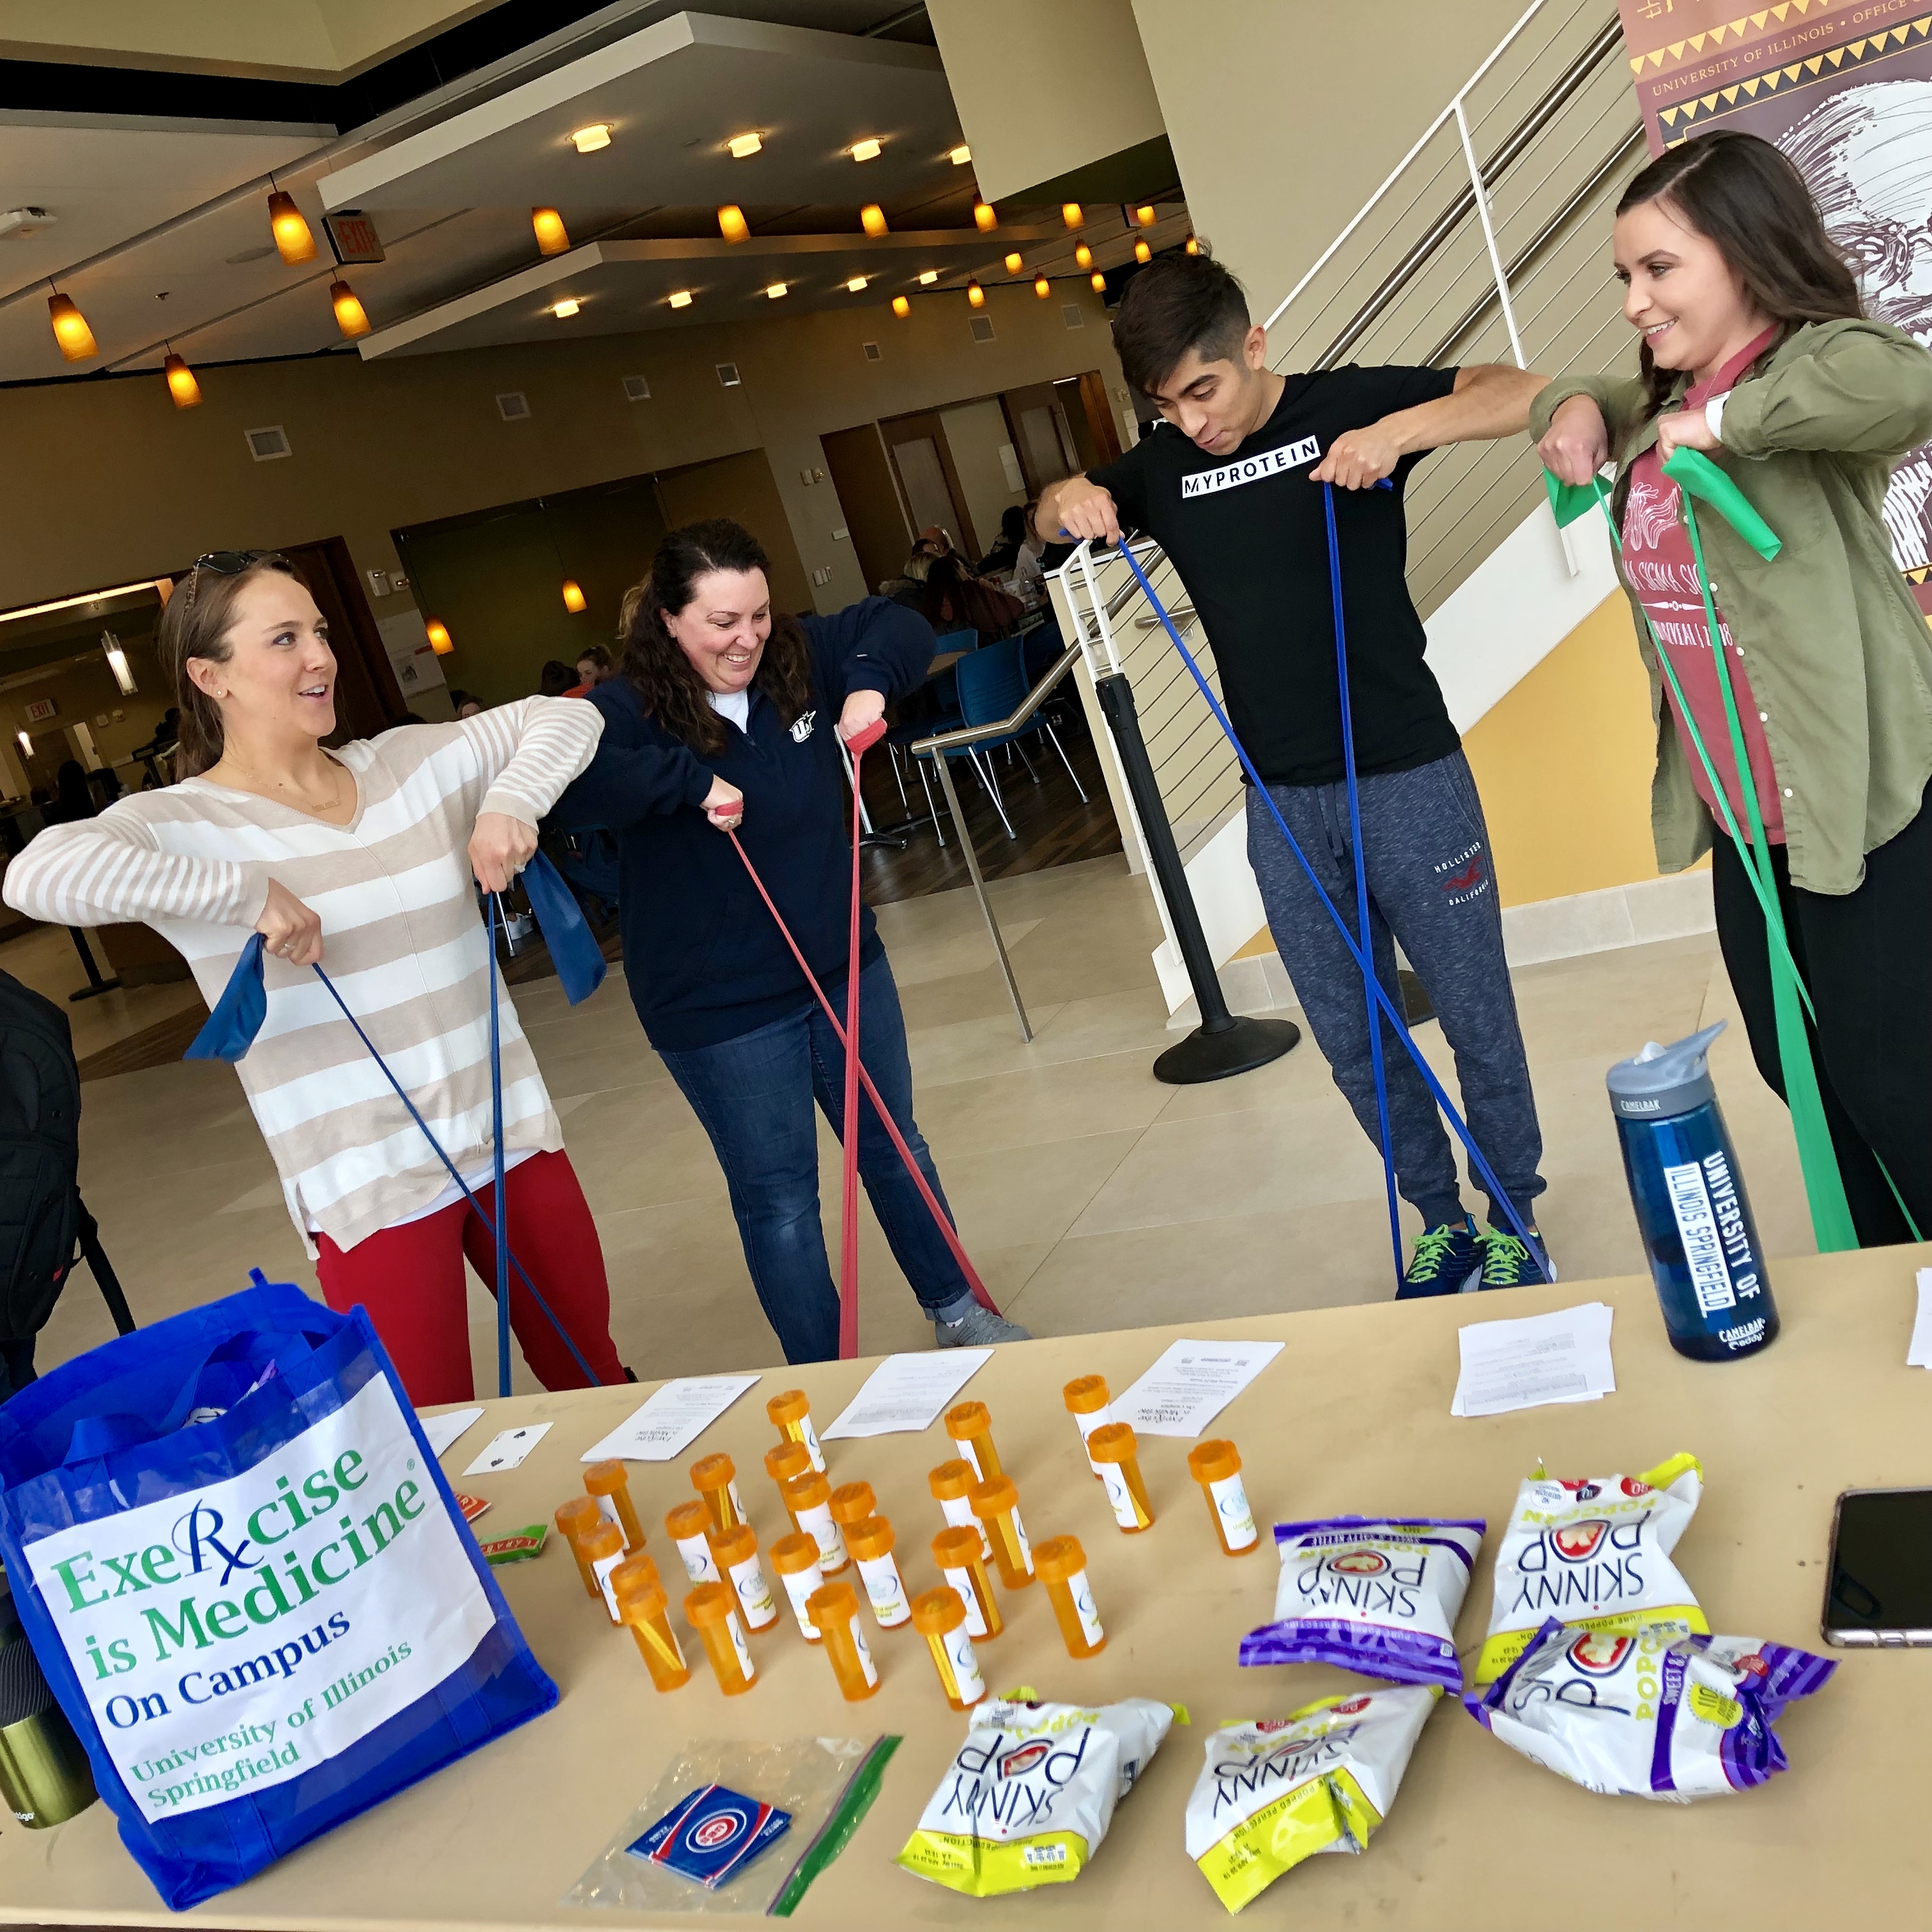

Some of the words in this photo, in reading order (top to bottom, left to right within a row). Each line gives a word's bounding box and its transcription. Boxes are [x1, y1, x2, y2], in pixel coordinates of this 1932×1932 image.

[1652, 56, 1740, 97] UNIVERSITY
[1744, 47, 1763, 63] OF
[1768, 22, 1835, 56] ILLINOIS
[1852, 0, 1908, 24] OFFICE
[338, 220, 375, 254] EXIT
[1184, 441, 1318, 494] MYPROTEIN
[1638, 561, 1687, 594] SIGMA
[1702, 623, 1733, 647] 218
[31, 702, 50, 718] EXIT
[1434, 841, 1481, 873] HOLLISTER
[1448, 879, 1489, 906] CALIFORNIA
[1620, 1099, 1661, 1112] CAMELBAK
[1669, 1167, 1708, 1223] ILLINOIS
[1703, 1150, 1753, 1268] UNIVERSITY
[1735, 1273, 1761, 1300] OF
[1685, 1225, 1731, 1308] SPRINGFIELD
[1719, 1317, 1766, 1344] CAMELBAK
[84, 1634, 137, 1681] is
[140, 1477, 426, 1662] Medicine
[1512, 1554, 1643, 1613] SKINNY
[105, 1690, 172, 1729] On
[178, 1611, 351, 1707] Campus
[1663, 1667, 1682, 1706] SWEET
[130, 1717, 277, 1785] University
[287, 1697, 318, 1729] of
[320, 1639, 413, 1711] Illinois
[147, 1741, 302, 1808] Springfield
